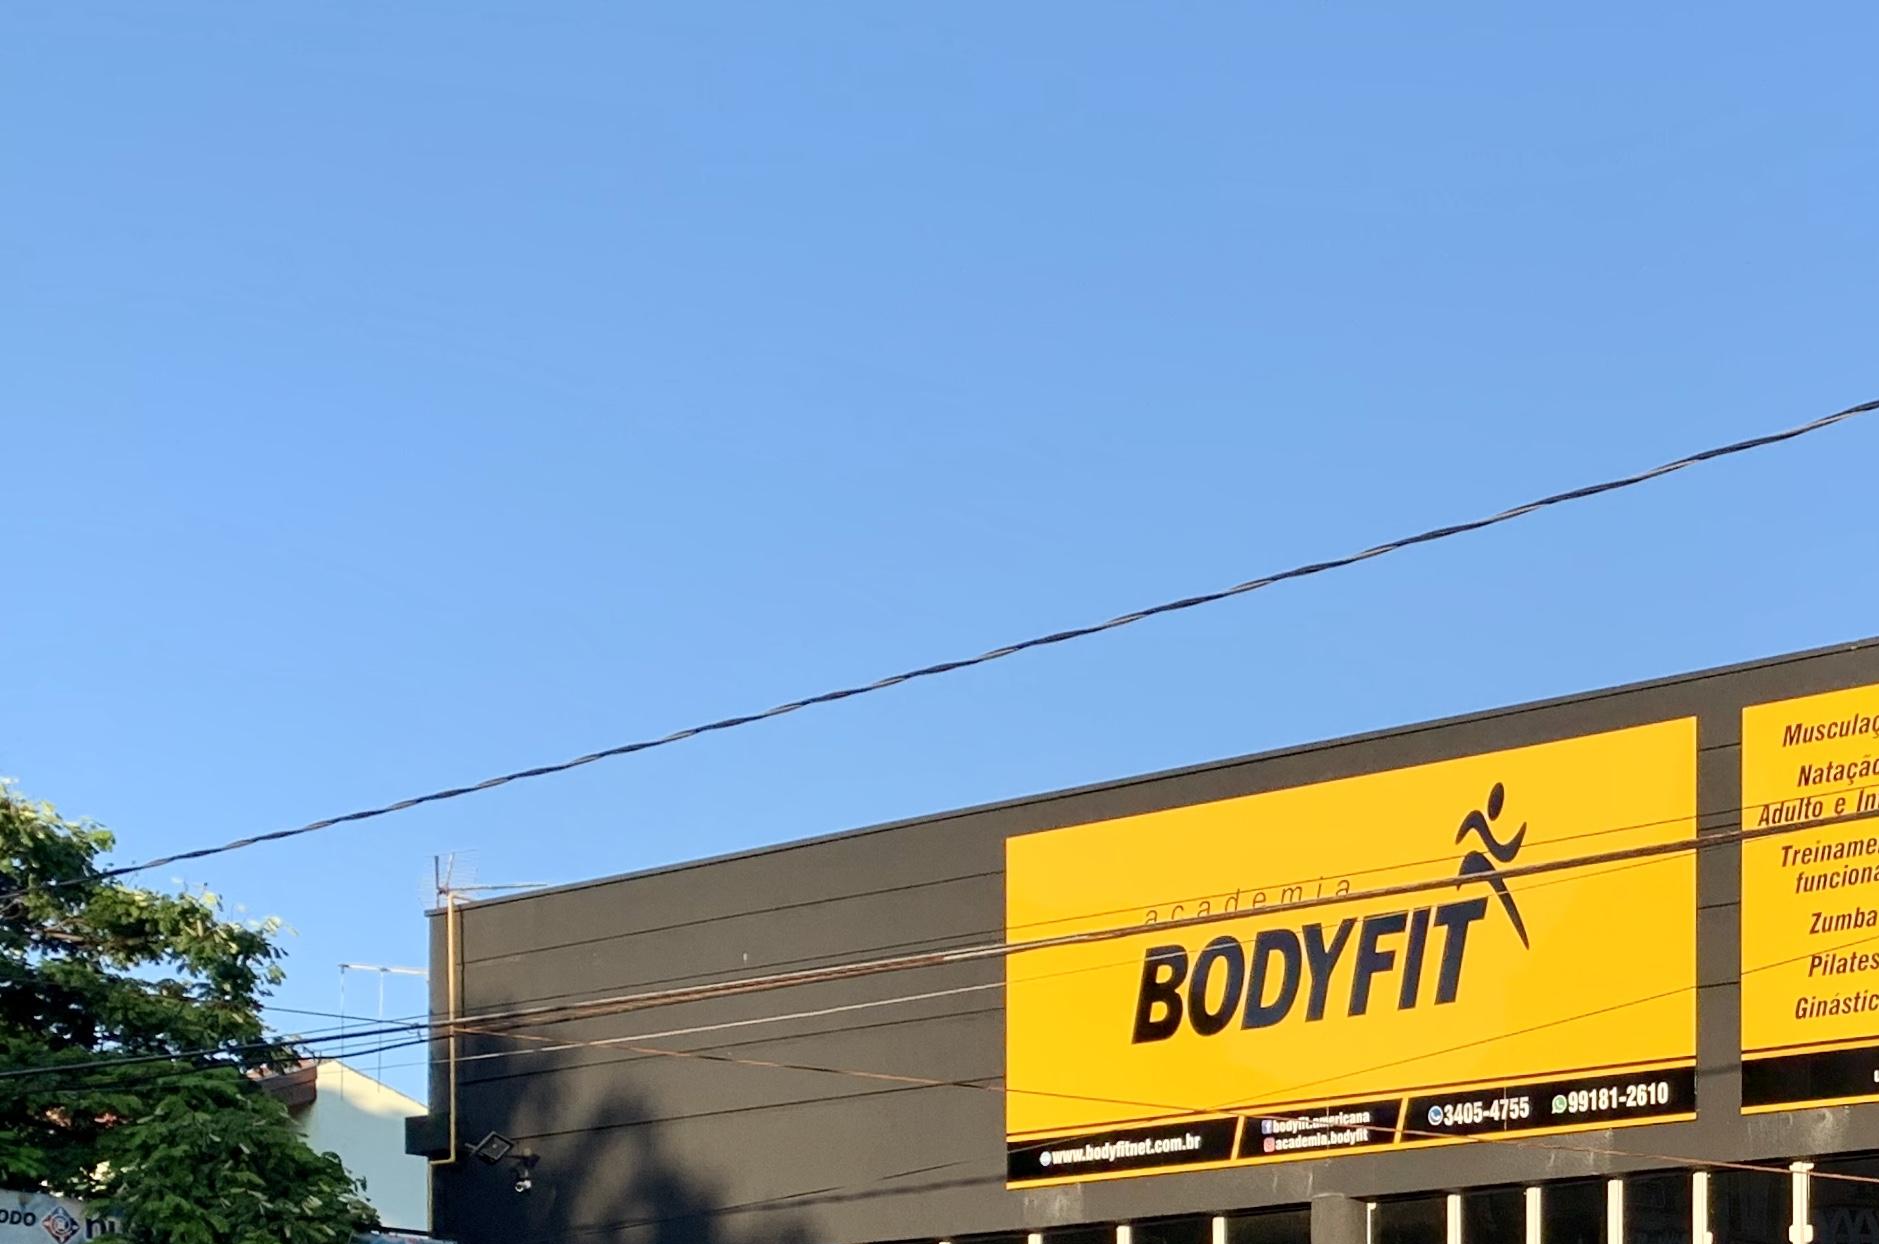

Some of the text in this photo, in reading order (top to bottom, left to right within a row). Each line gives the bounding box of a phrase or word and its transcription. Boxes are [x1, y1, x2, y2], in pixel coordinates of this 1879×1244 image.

[1758, 796, 1823, 826] Adulto
[1834, 797, 1846, 815] e
[1144, 876, 1351, 925] academia
[1809, 907, 1878, 934] Zumba
[1131, 895, 1489, 1045] BODYFIT
[1443, 1081, 1669, 1126] 3405-4755 99181-2610
[1272, 1111, 1371, 1134] bodyfit.americana
[1051, 1132, 1201, 1166] www.bodyfitnet.com.br
[1275, 1128, 1369, 1151] academia.bodyfit
